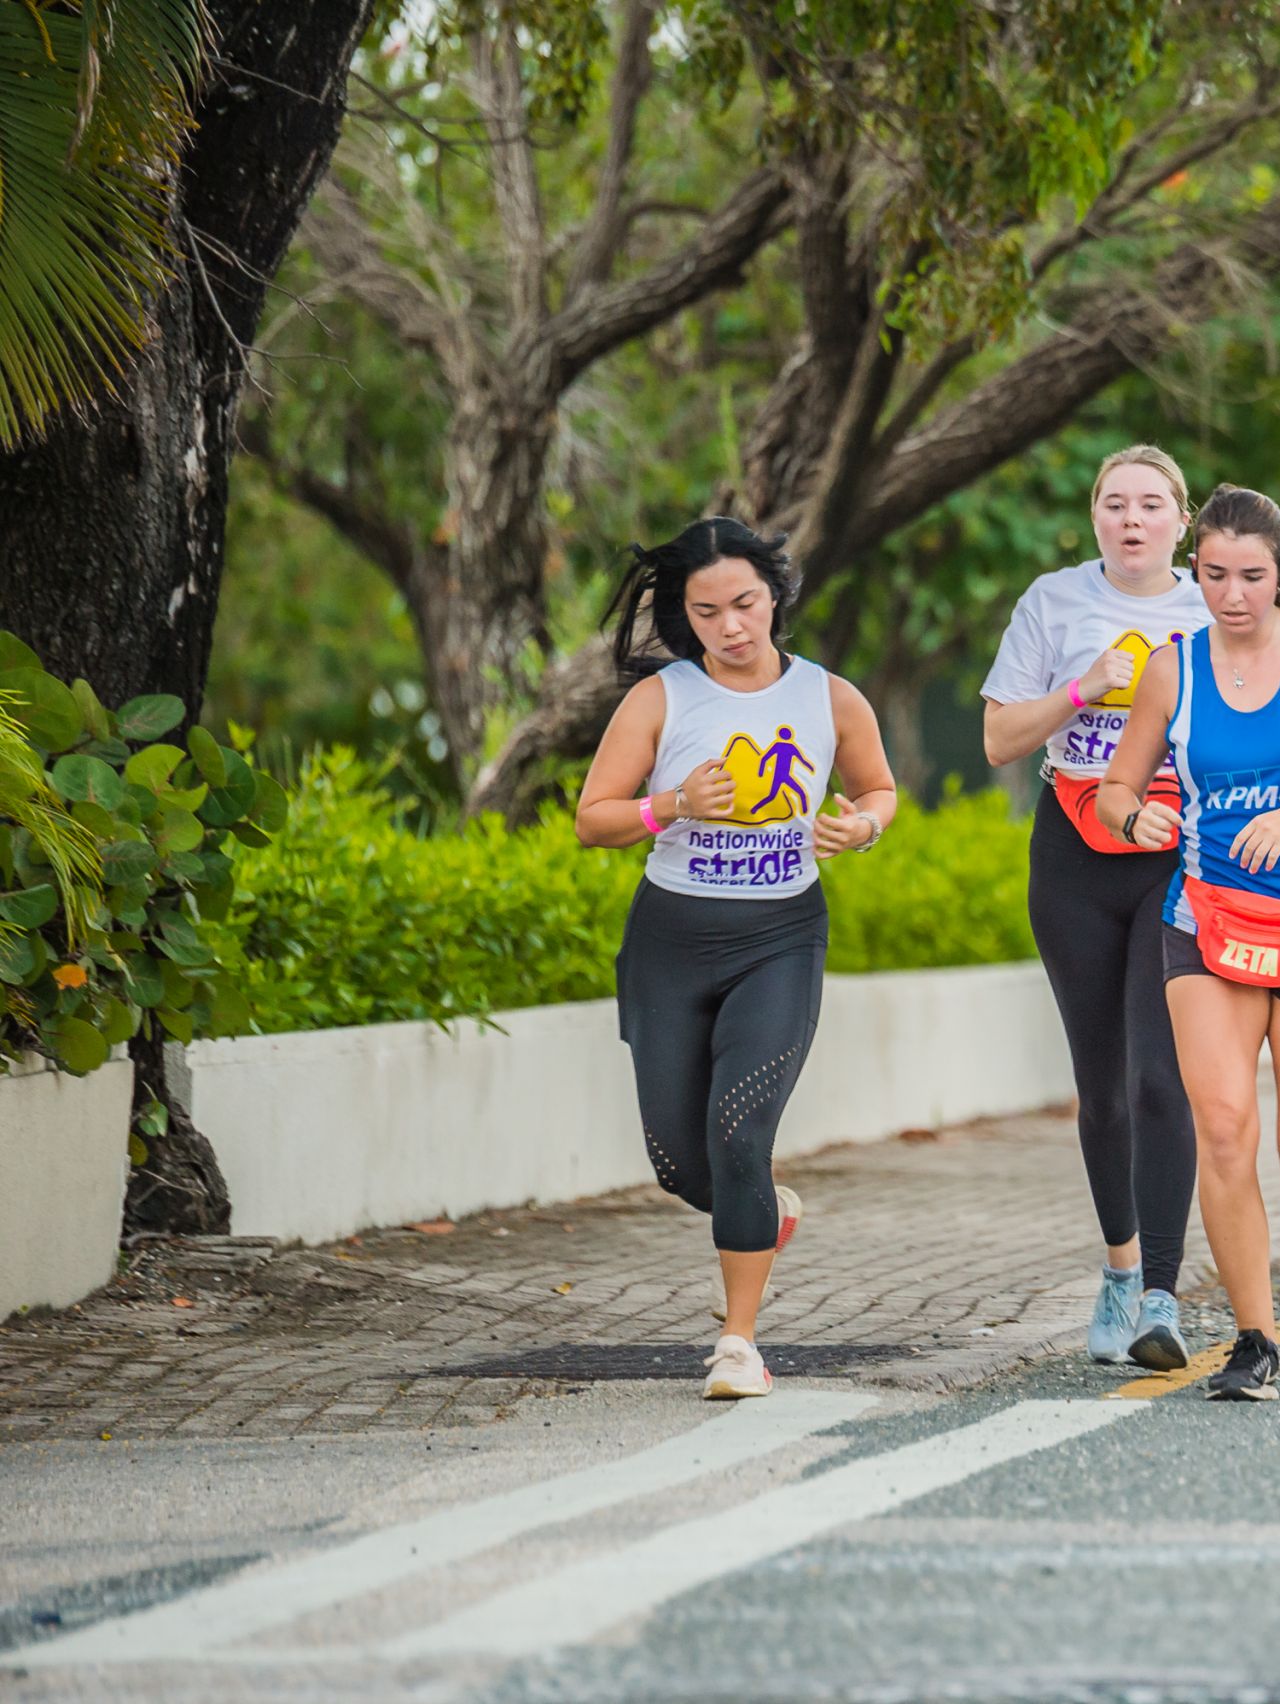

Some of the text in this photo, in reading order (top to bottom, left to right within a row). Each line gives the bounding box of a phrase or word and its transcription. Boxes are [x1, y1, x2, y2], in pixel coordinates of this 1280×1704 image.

[688, 829, 803, 849] nationwide
[688, 849, 801, 877] stride
[1219, 938, 1279, 978] ZETA
